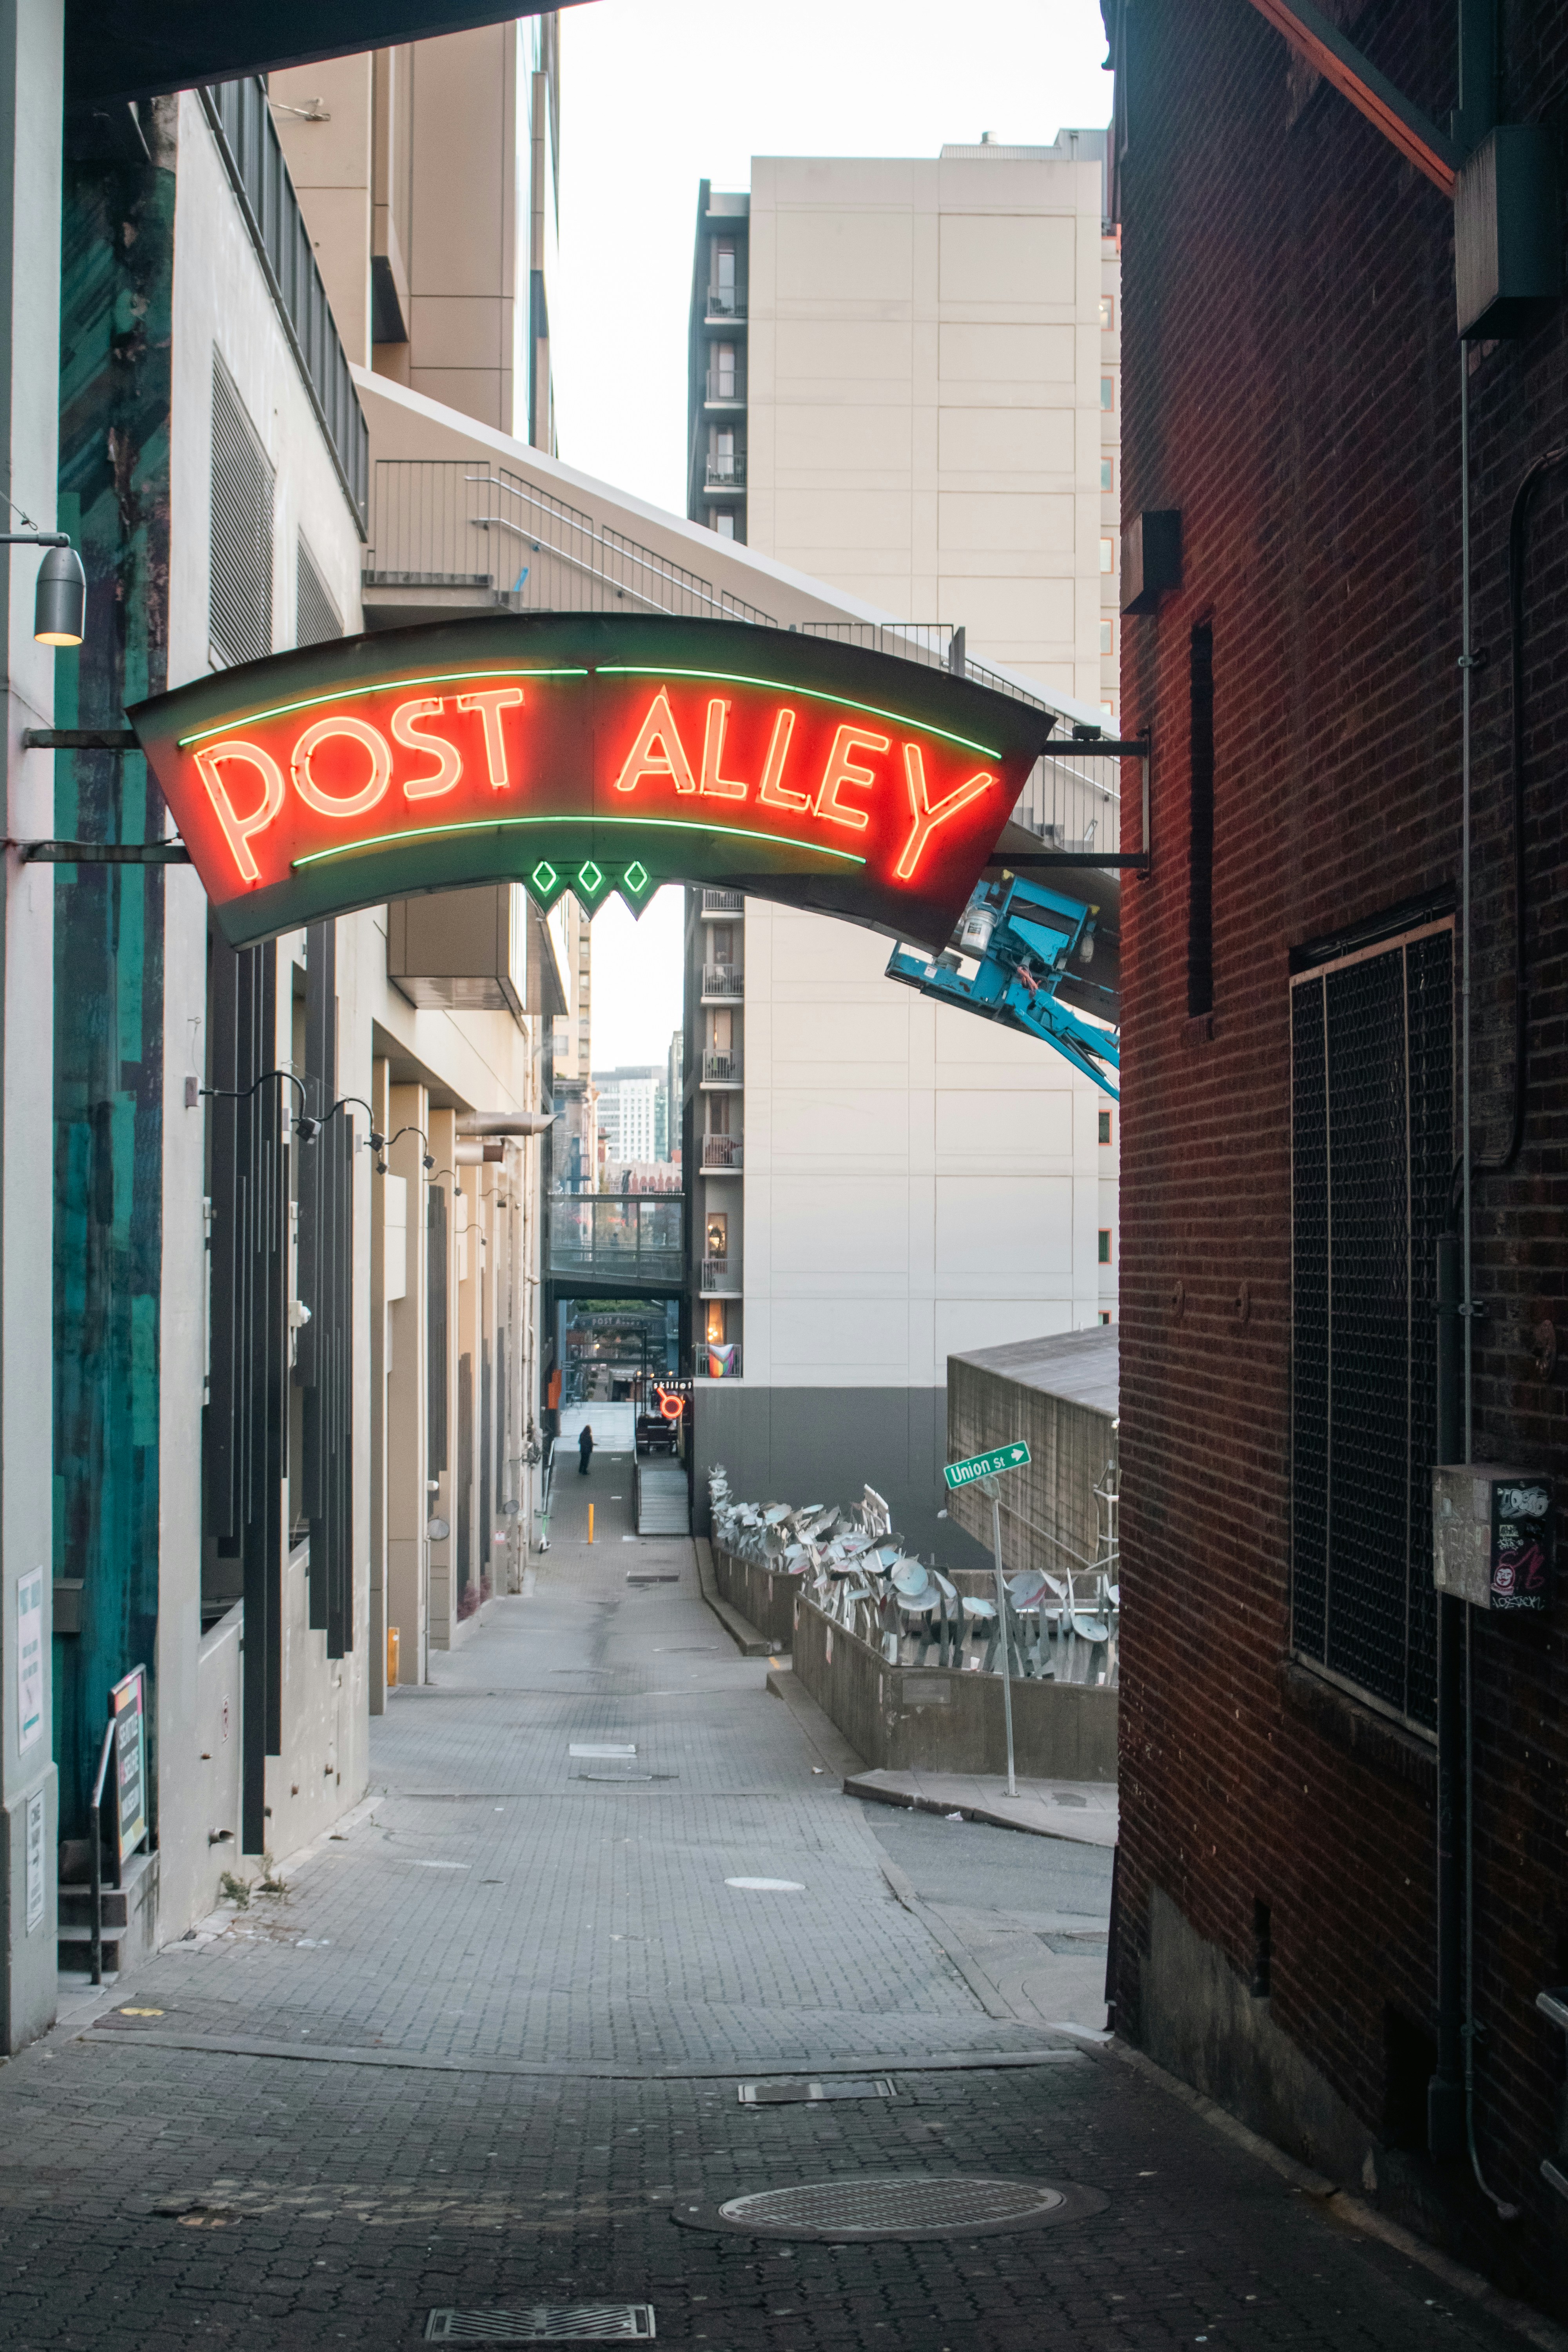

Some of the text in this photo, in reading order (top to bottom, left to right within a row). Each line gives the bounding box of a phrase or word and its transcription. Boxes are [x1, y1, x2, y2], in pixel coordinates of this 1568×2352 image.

[194, 684, 999, 883] POST ALLEY
[592, 1317, 612, 1326] POST
[653, 1381, 692, 1389] skillet
[951, 1457, 1005, 1483] Union St
